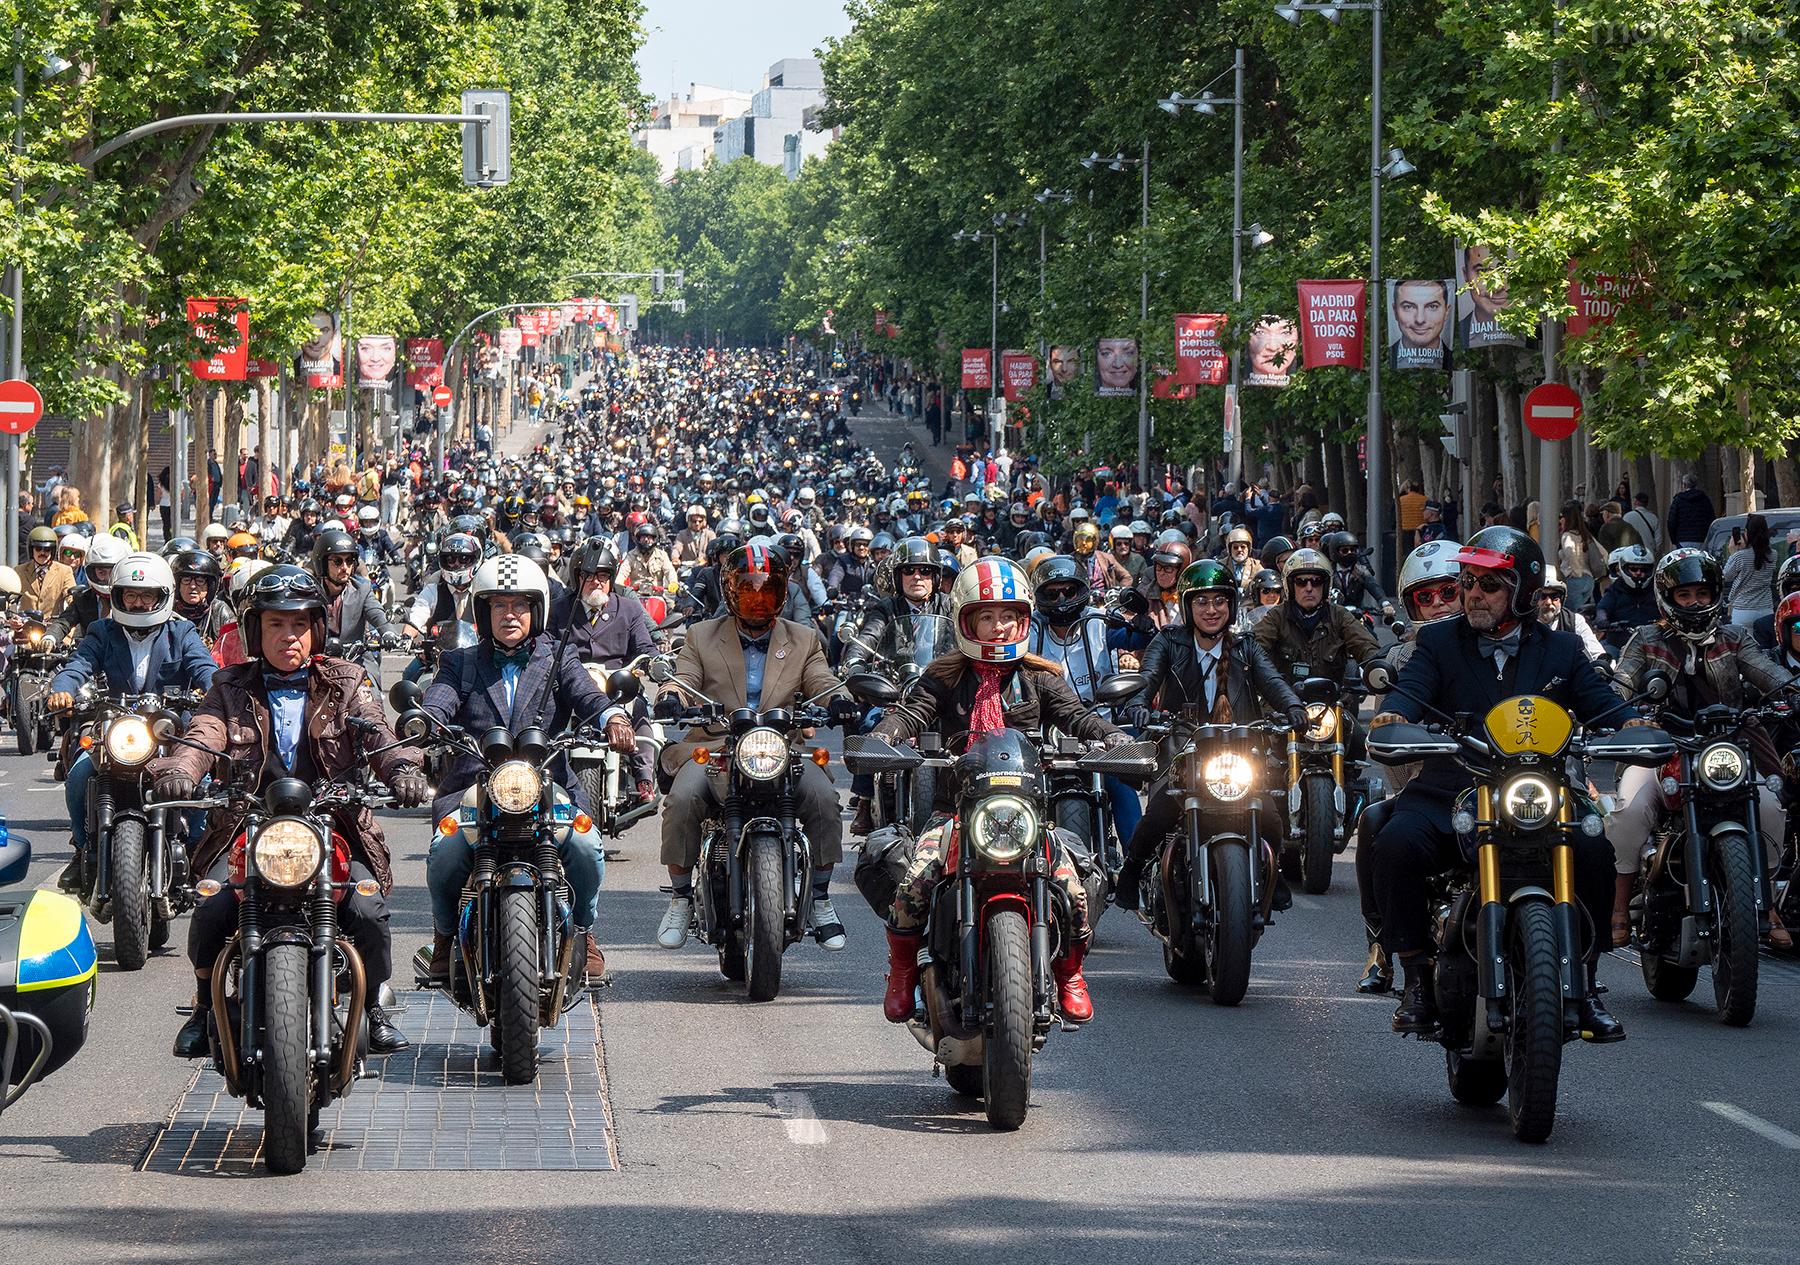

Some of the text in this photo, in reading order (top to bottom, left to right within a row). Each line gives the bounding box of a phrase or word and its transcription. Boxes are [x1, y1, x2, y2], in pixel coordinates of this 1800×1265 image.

[1311, 295, 1355, 308] MADRID
[1310, 309, 1358, 323] DA PARA
[1179, 327, 1215, 338] Lo que
[1470, 321, 1494, 334] JUAN
[1179, 347, 1224, 358] importa.
[1326, 351, 1345, 359] PSOE
[1397, 348, 1444, 359] JUAN LOBATO
[1200, 360, 1224, 368] VOTA
[208, 366, 226, 374] PSOE
